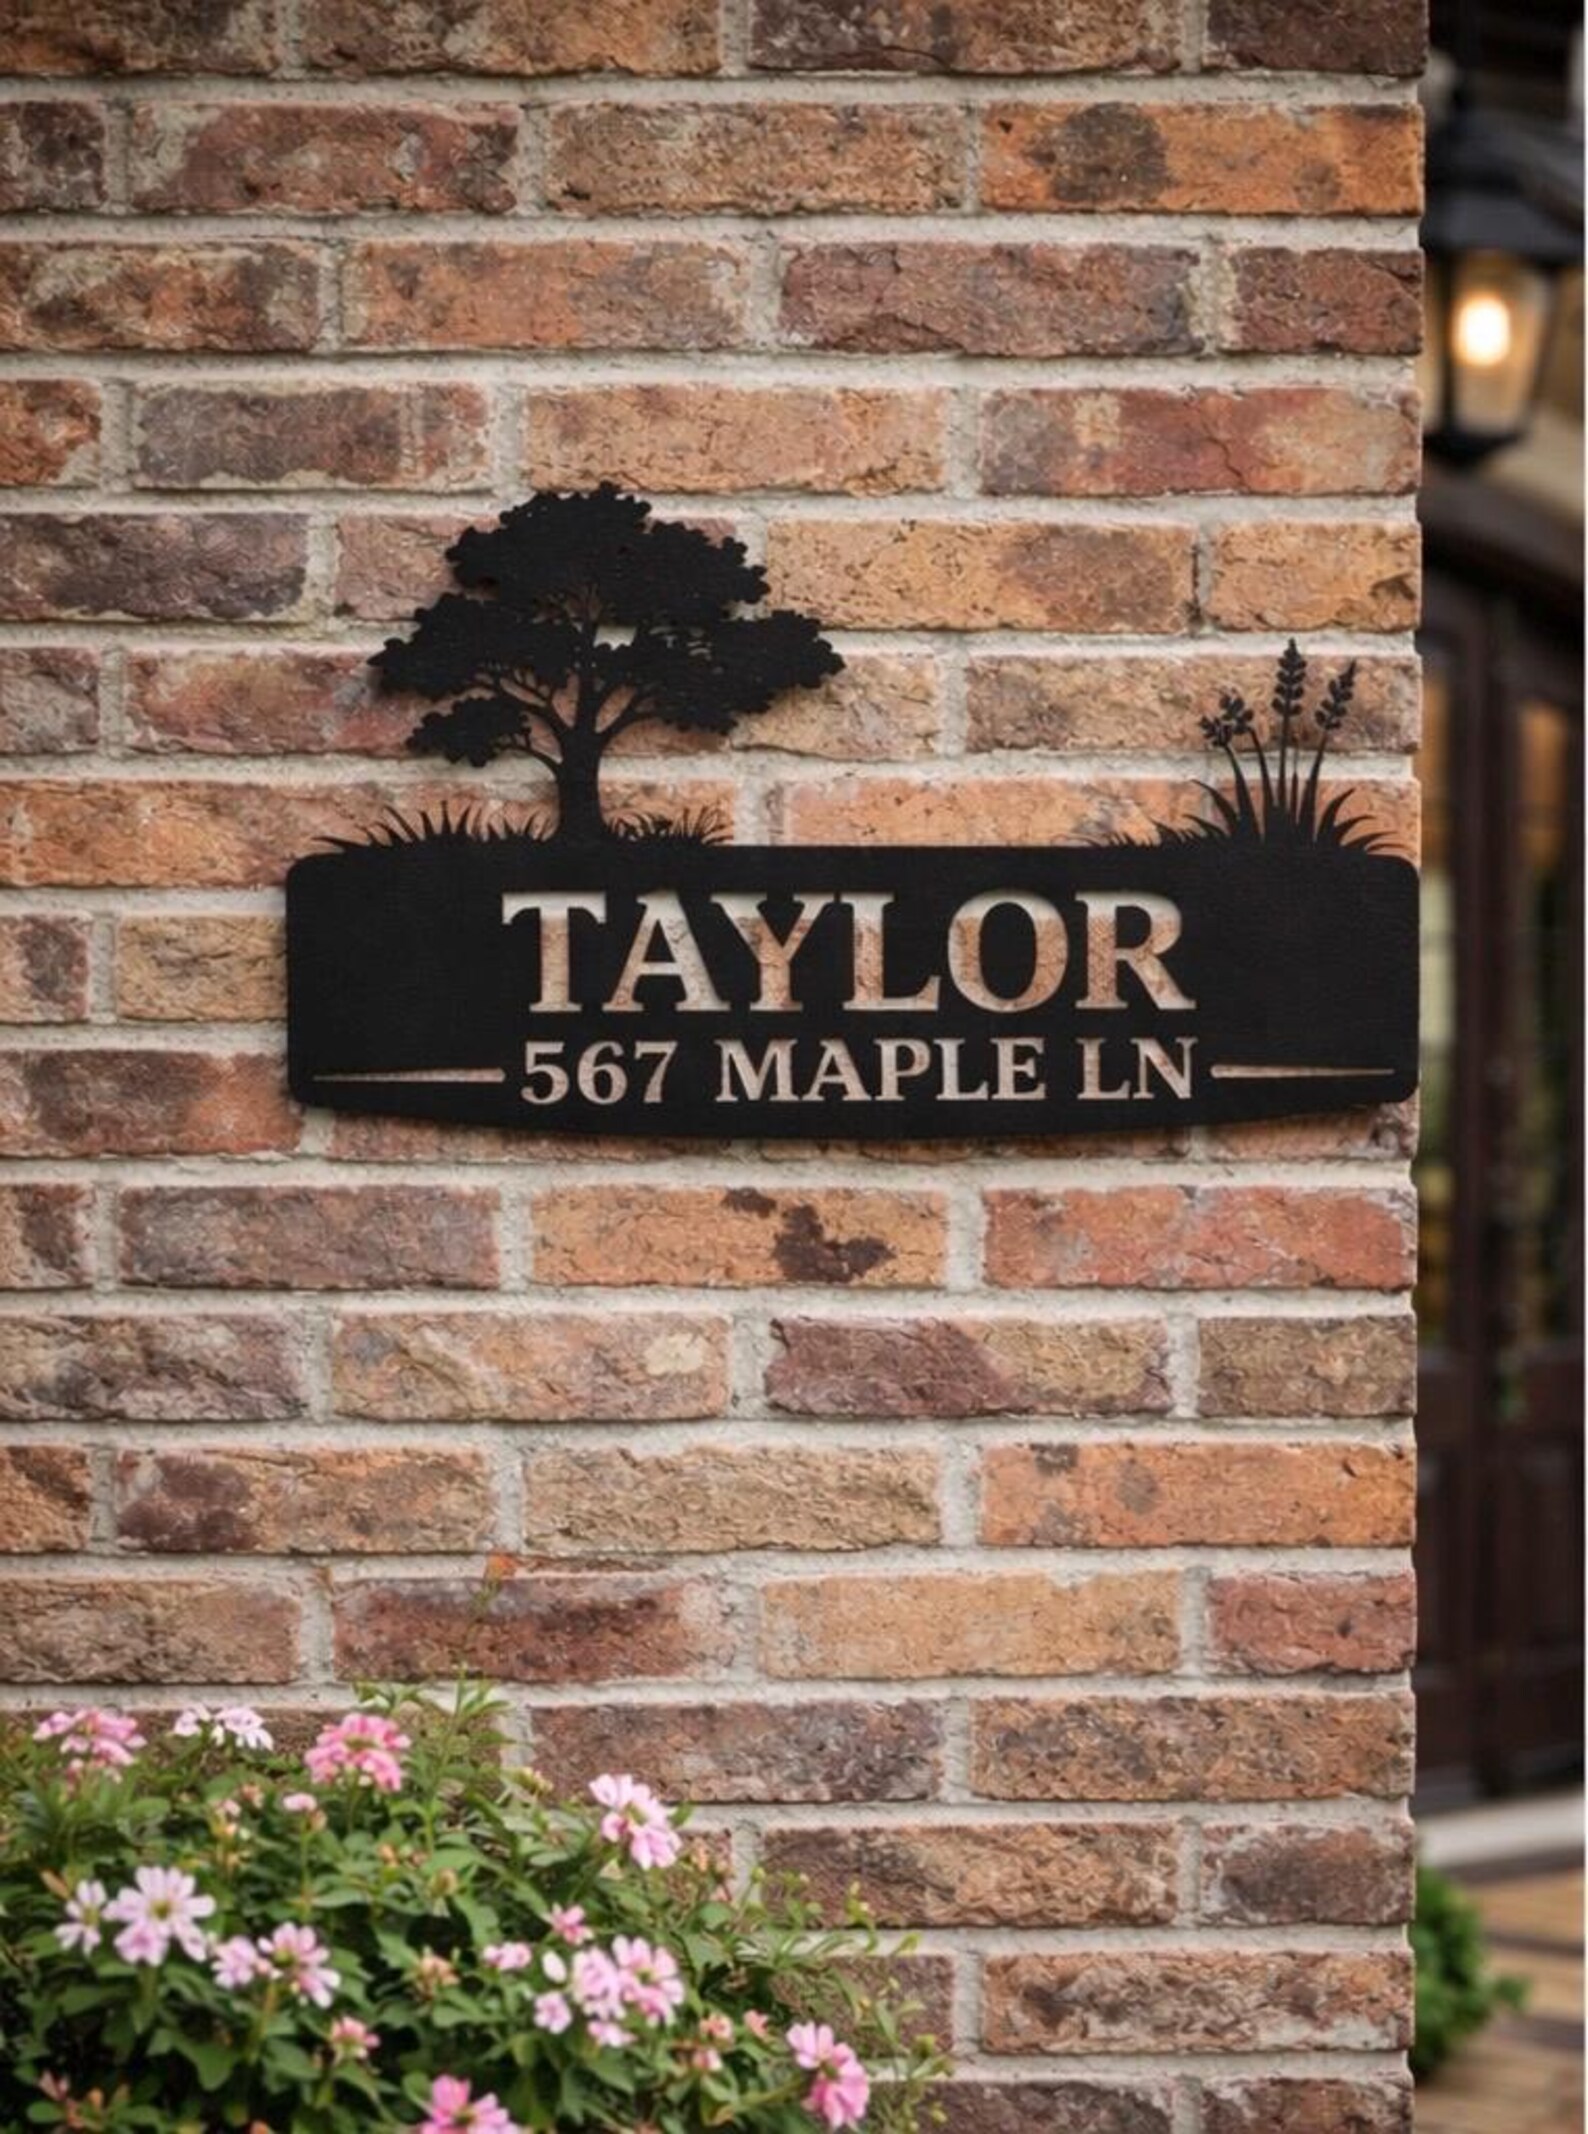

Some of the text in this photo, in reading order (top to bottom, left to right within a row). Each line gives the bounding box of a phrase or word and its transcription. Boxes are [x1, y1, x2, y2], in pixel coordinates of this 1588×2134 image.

[501, 892, 1197, 1013] TAYLOR
[521, 1037, 1198, 1105] 567 MAPLE LN
